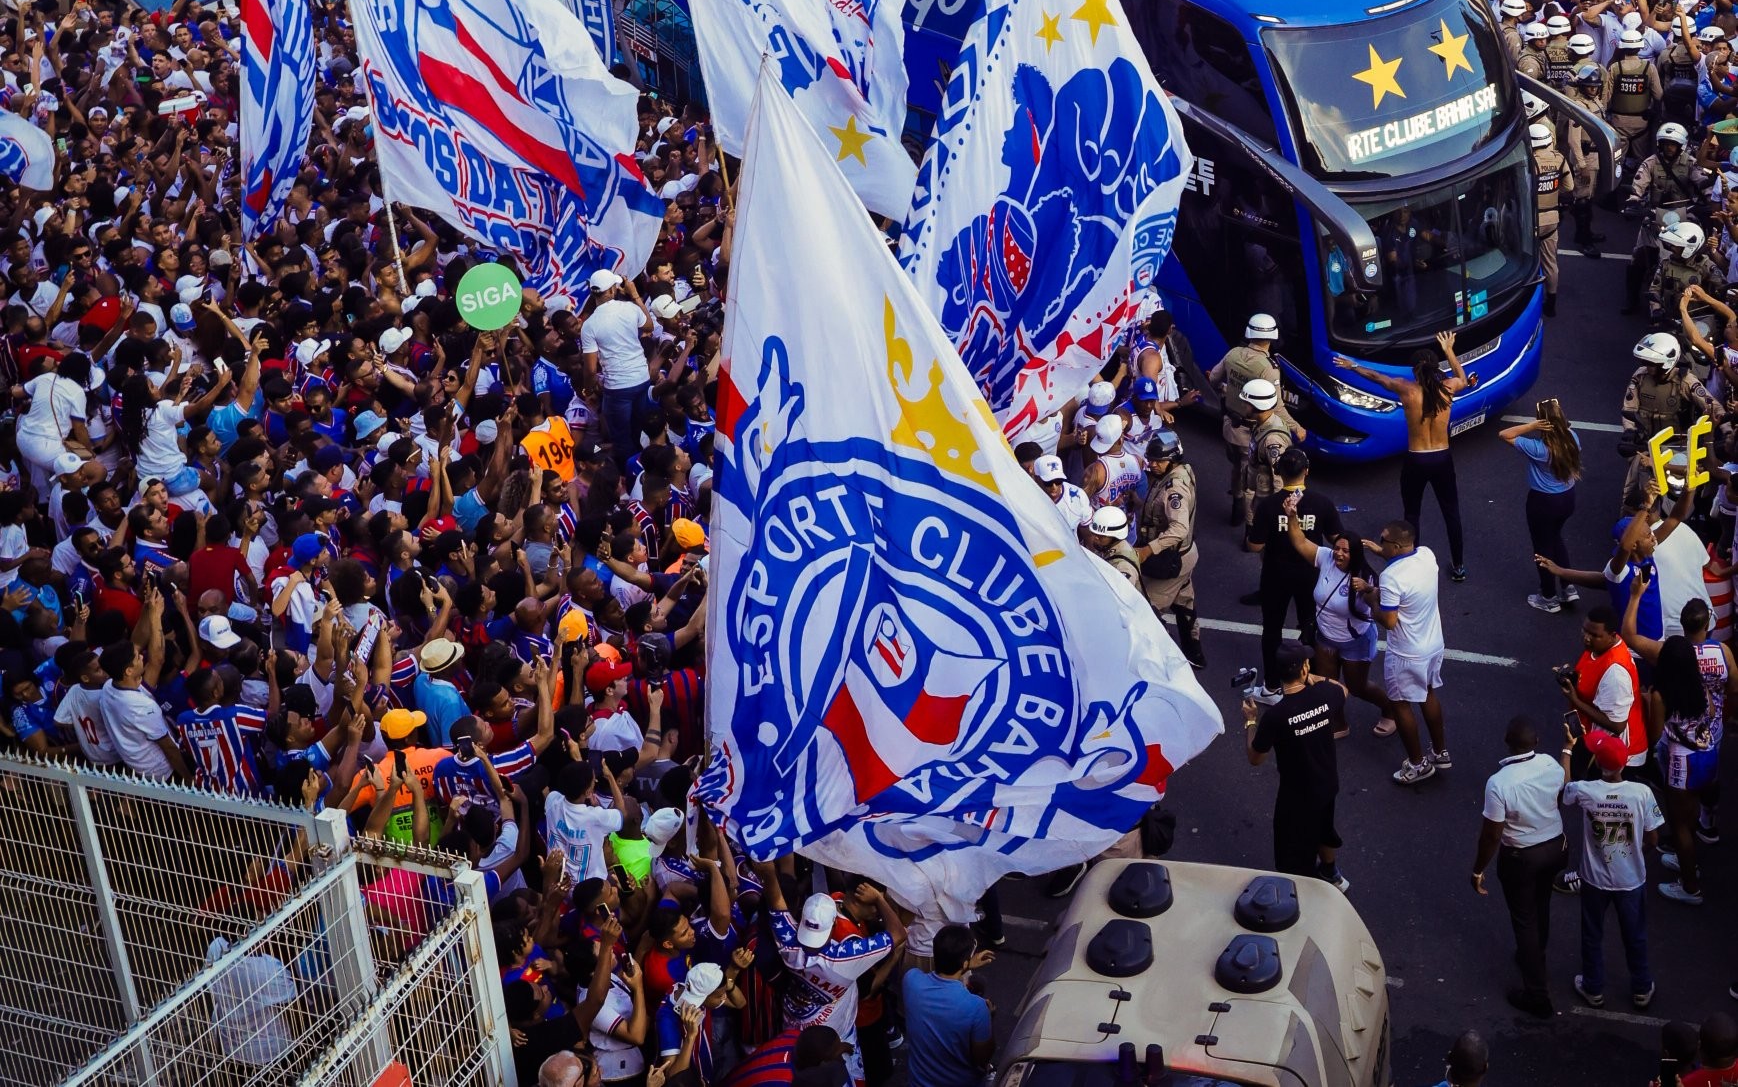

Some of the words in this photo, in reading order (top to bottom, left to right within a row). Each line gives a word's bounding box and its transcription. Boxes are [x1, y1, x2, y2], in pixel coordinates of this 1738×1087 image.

[1621, 83, 1636, 92] 3316
[1384, 111, 1436, 148] CLUBE
[1436, 95, 1475, 131] BAHIA
[461, 282, 518, 313] SIGA
[539, 438, 572, 469] 196
[743, 484, 888, 697] ESPORTE
[910, 516, 1066, 679] CLUBE
[1288, 704, 1330, 725] FOTOGRAFIA
[198, 739, 220, 777] 7
[636, 777, 660, 790] TV
